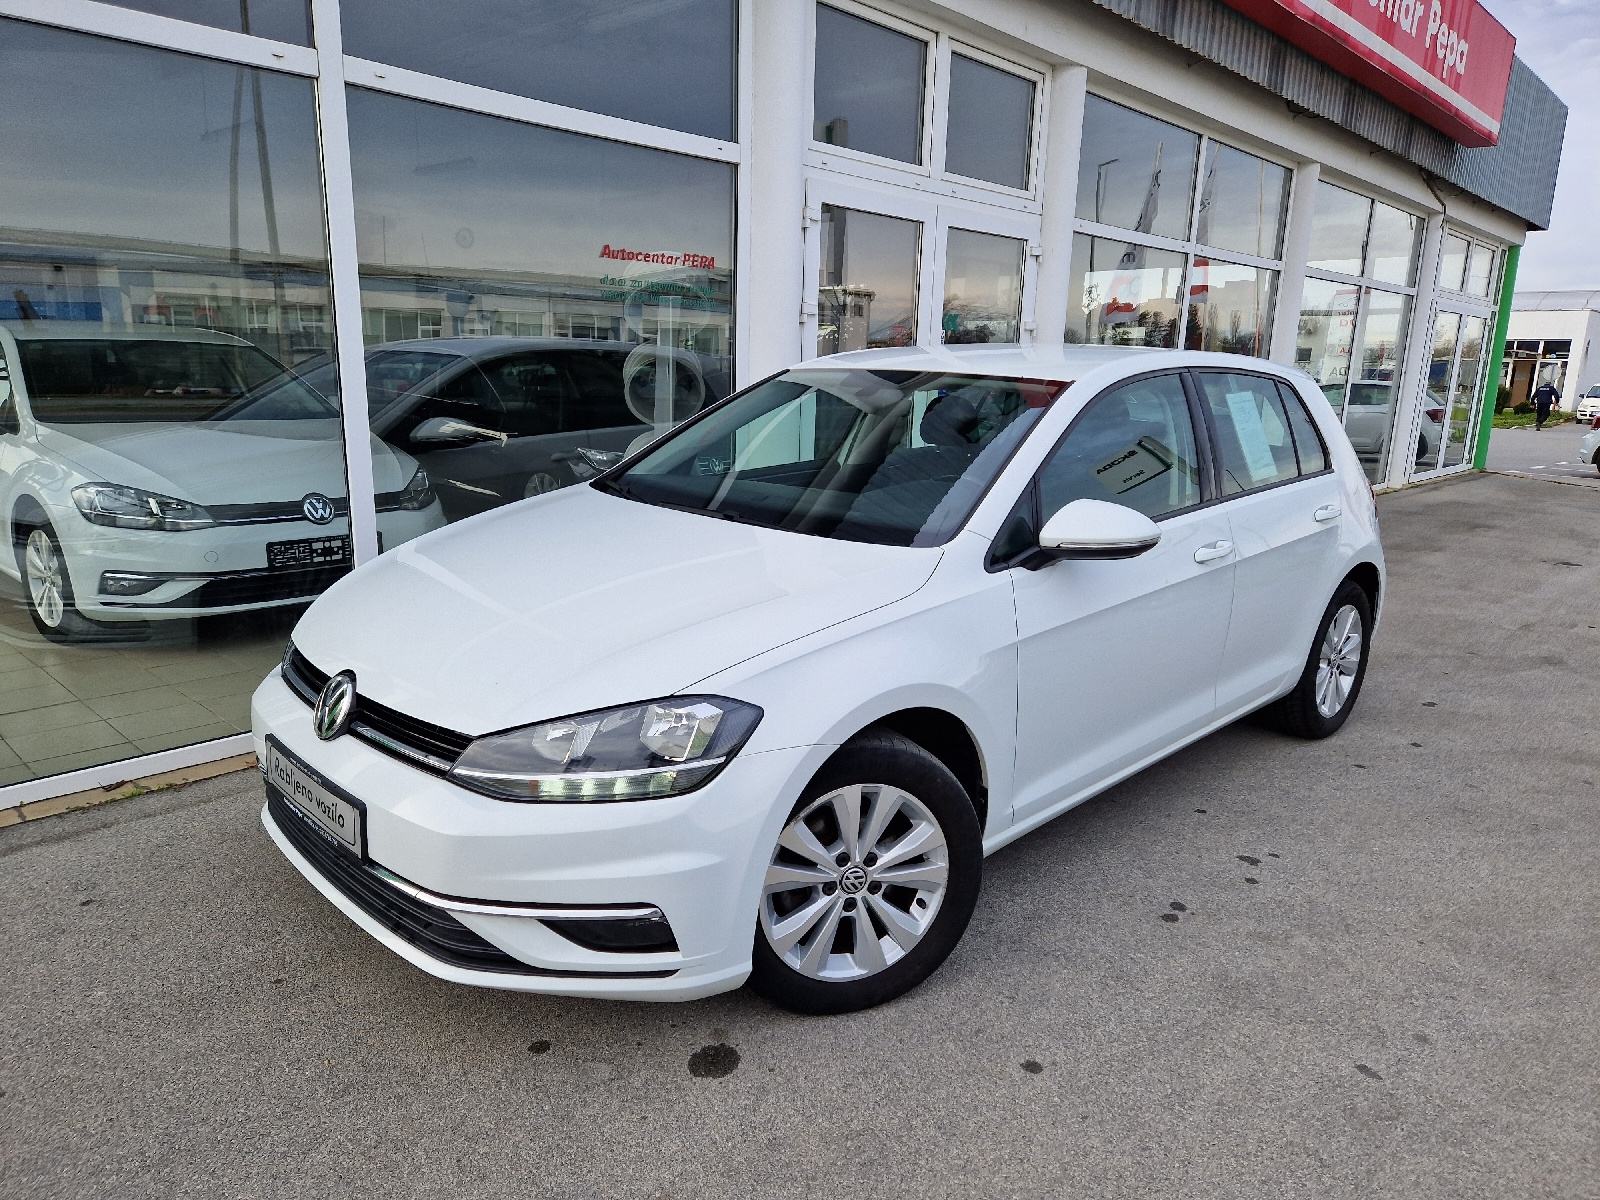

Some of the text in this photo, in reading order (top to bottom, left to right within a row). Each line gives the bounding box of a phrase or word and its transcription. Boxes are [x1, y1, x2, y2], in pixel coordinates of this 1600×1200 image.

[1425, 0, 1469, 79] Pepa
[599, 244, 716, 270] Autocentar PEPA
[275, 757, 313, 803] Rabljeno
[315, 796, 345, 829] vozilo
